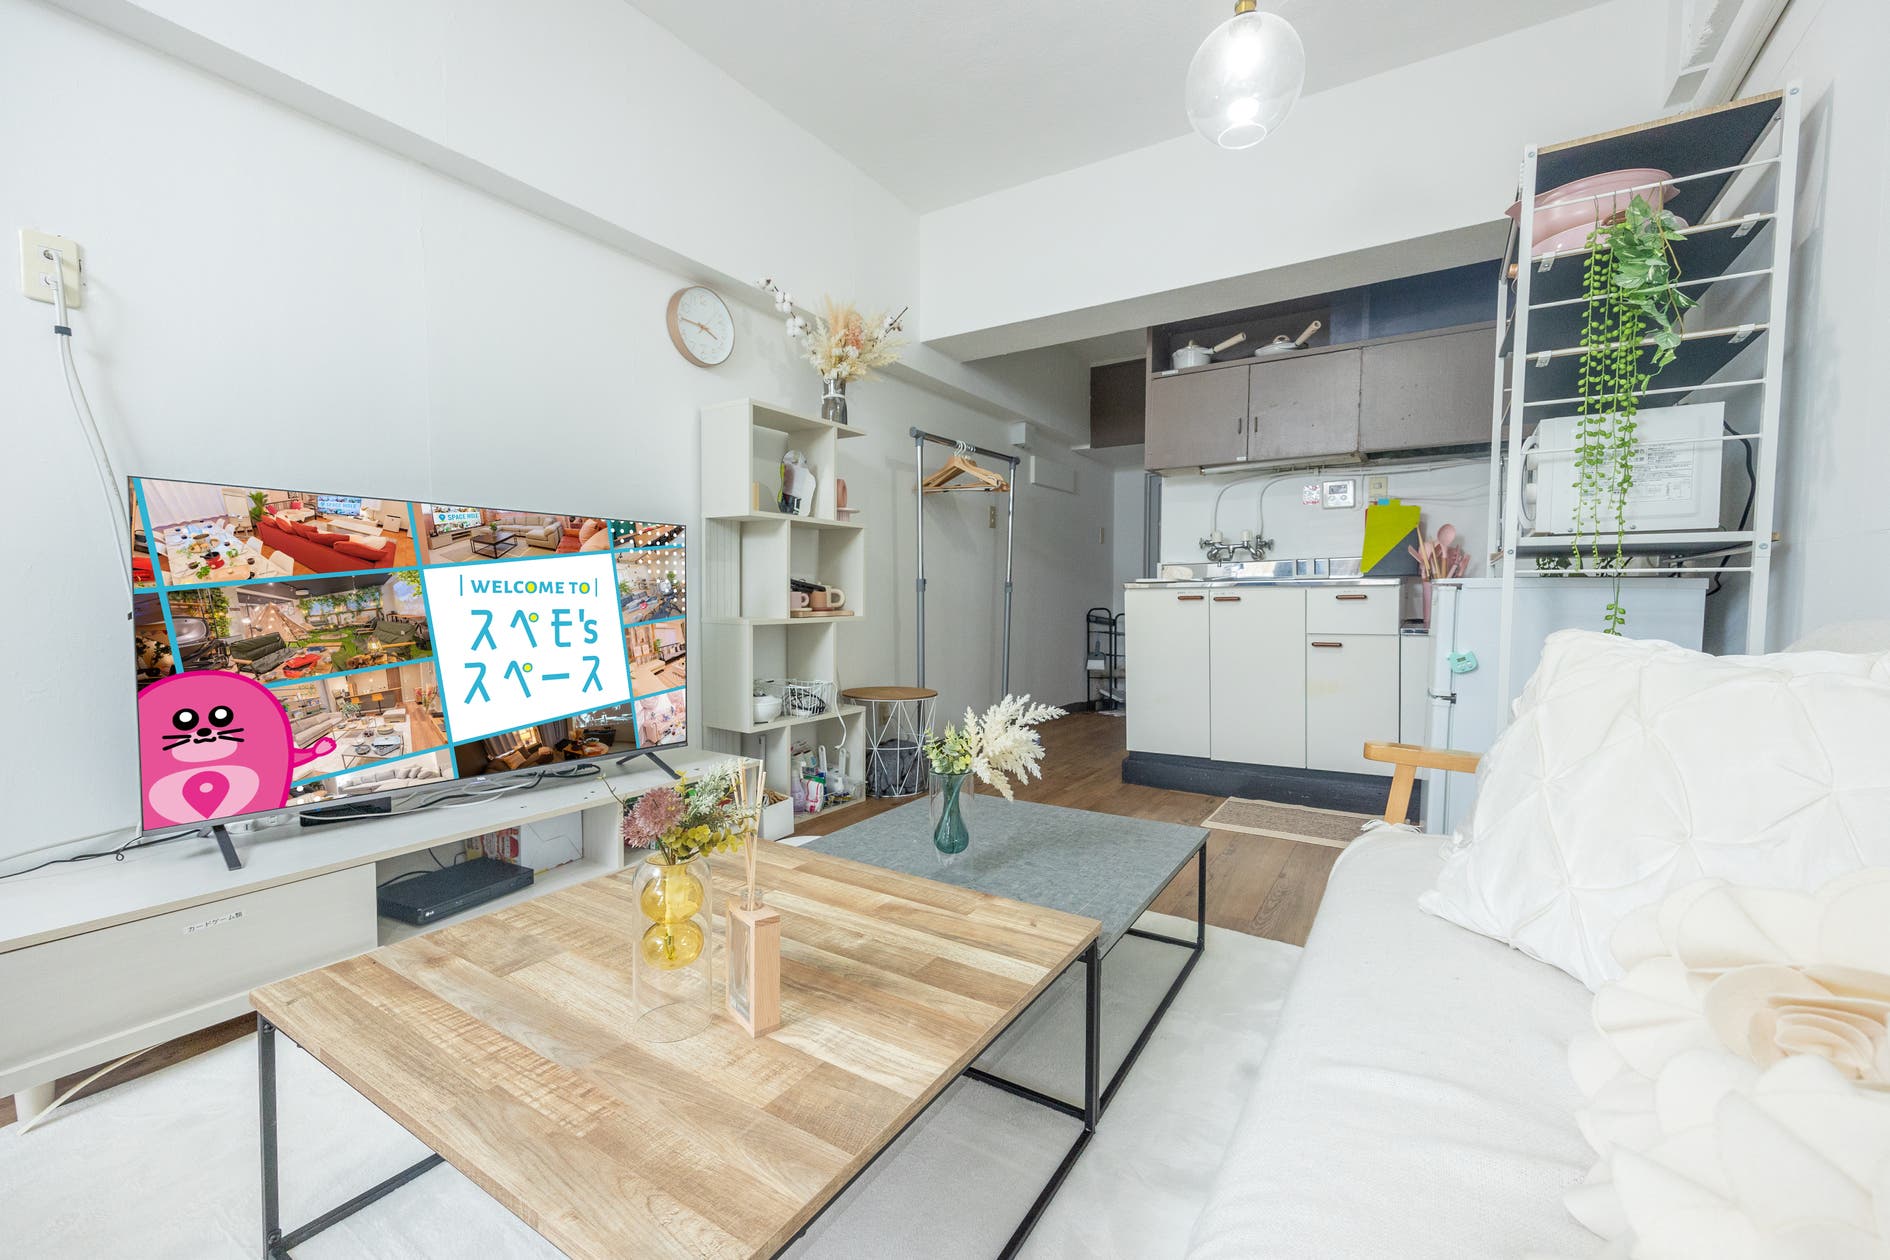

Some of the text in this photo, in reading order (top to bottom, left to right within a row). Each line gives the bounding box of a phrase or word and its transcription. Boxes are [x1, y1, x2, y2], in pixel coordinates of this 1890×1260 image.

[447, 513, 466, 521] SPACE
[470, 579, 591, 595] WELCOME TO
[470, 608, 598, 651] スペモ's
[464, 655, 603, 704] スペース
